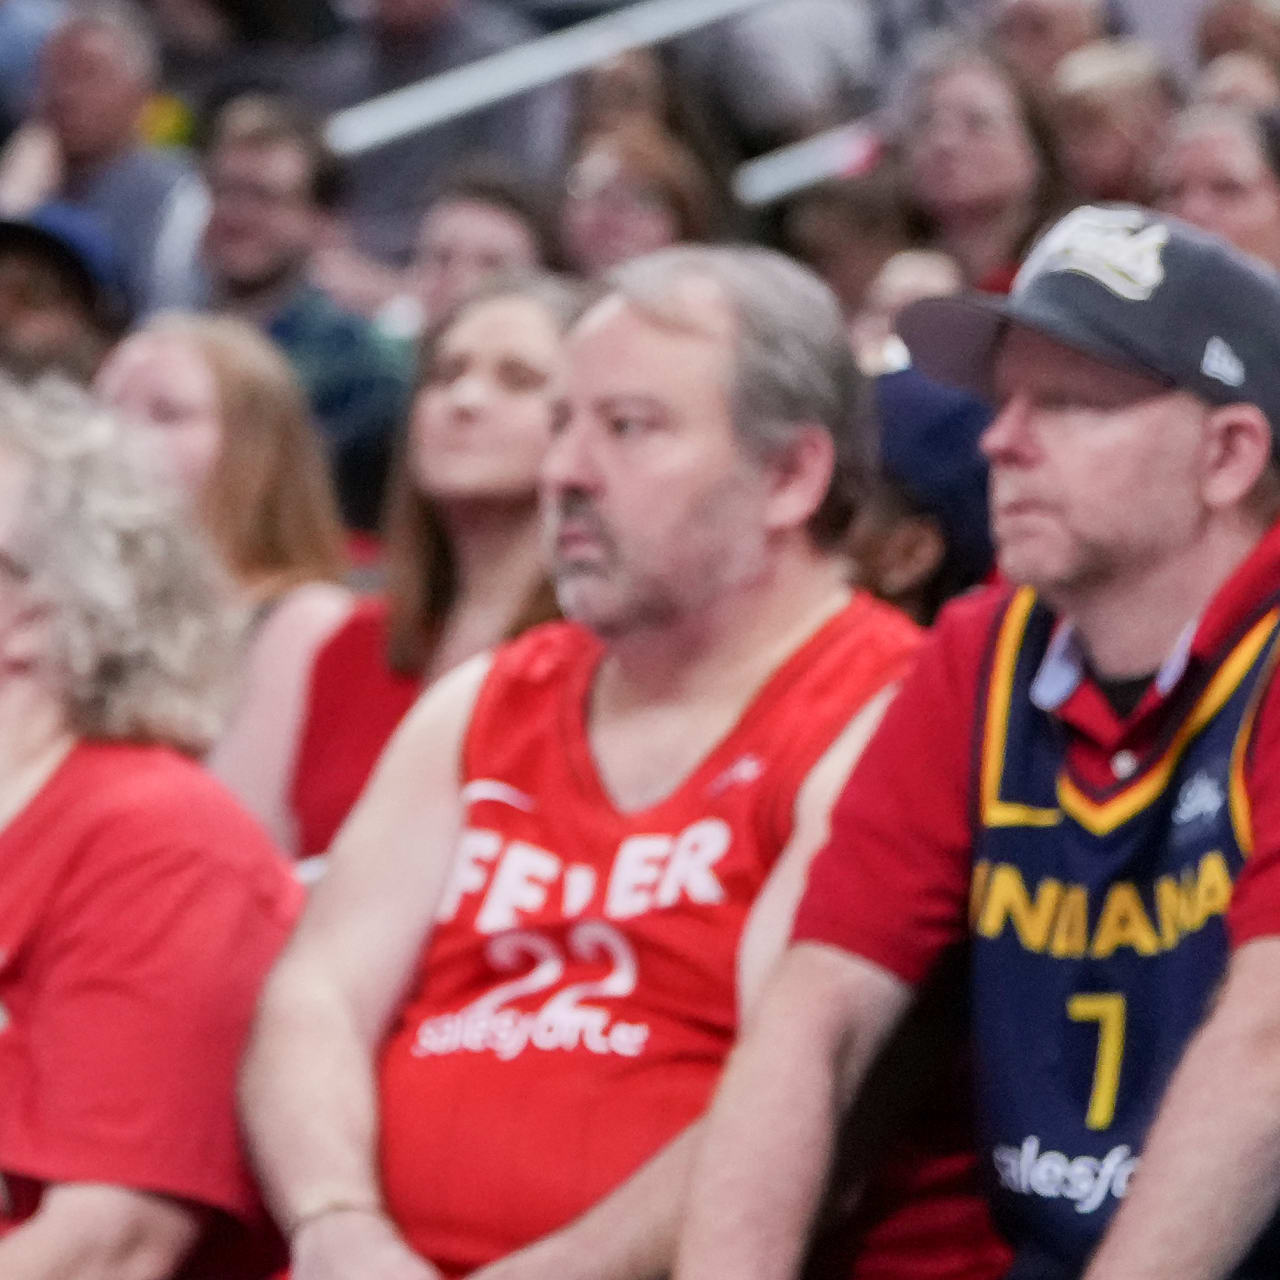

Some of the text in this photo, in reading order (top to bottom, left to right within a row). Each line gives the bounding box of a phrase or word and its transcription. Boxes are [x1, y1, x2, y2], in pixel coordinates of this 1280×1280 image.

[969, 849, 1235, 958] INIANA
[450, 920, 639, 1028] 22
[1066, 992, 1128, 1131] 7
